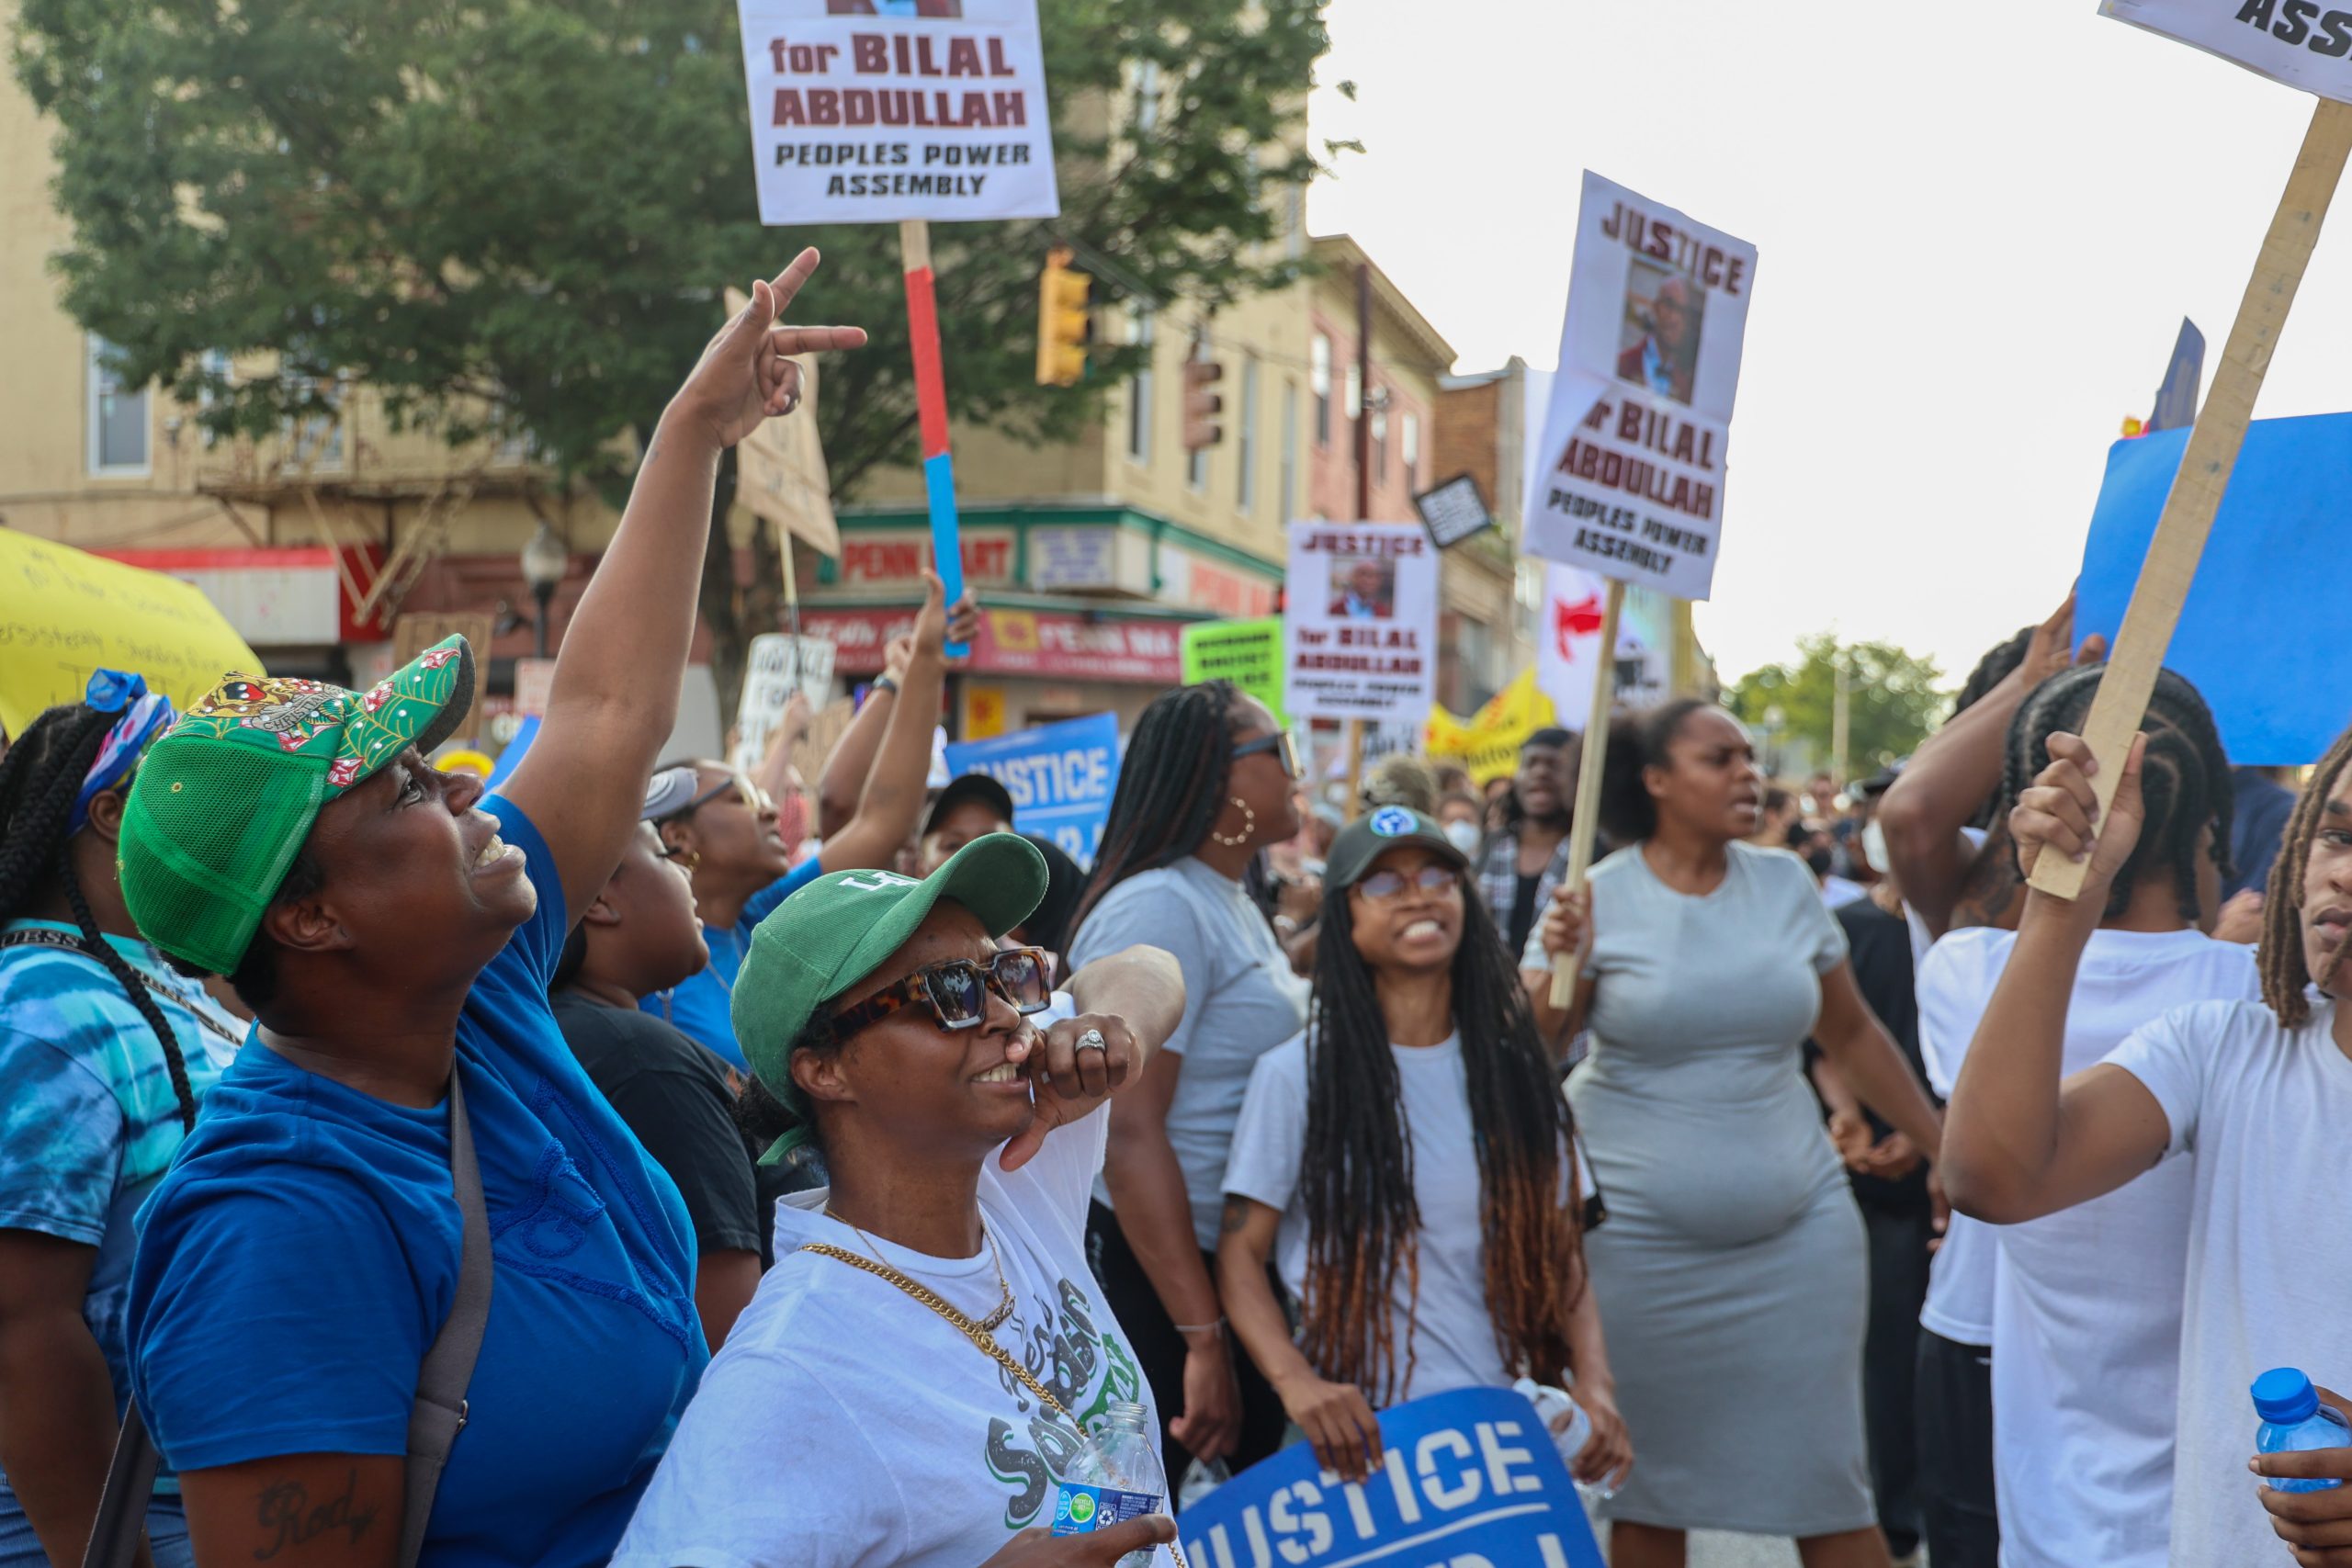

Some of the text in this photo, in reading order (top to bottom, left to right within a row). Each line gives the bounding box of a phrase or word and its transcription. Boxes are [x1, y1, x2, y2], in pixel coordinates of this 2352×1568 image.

[770, 33, 1015, 77] for BILAL
[2234, 0, 2352, 61] ASS
[772, 87, 1027, 127] ABDULLAH
[775, 142, 1030, 166] PEOPLES POWER
[827, 174, 986, 197] ASSEMBLY
[1601, 201, 1746, 296] JUSTICE
[1617, 399, 1714, 469] BILAL
[1557, 437, 1714, 520] ABDULLAH
[1302, 532, 1424, 556] JUSTICE
[1546, 487, 1710, 556] PEOPLES POWER
[1572, 527, 1674, 574] ASSEMBLY
[968, 746, 1108, 807] STICE
